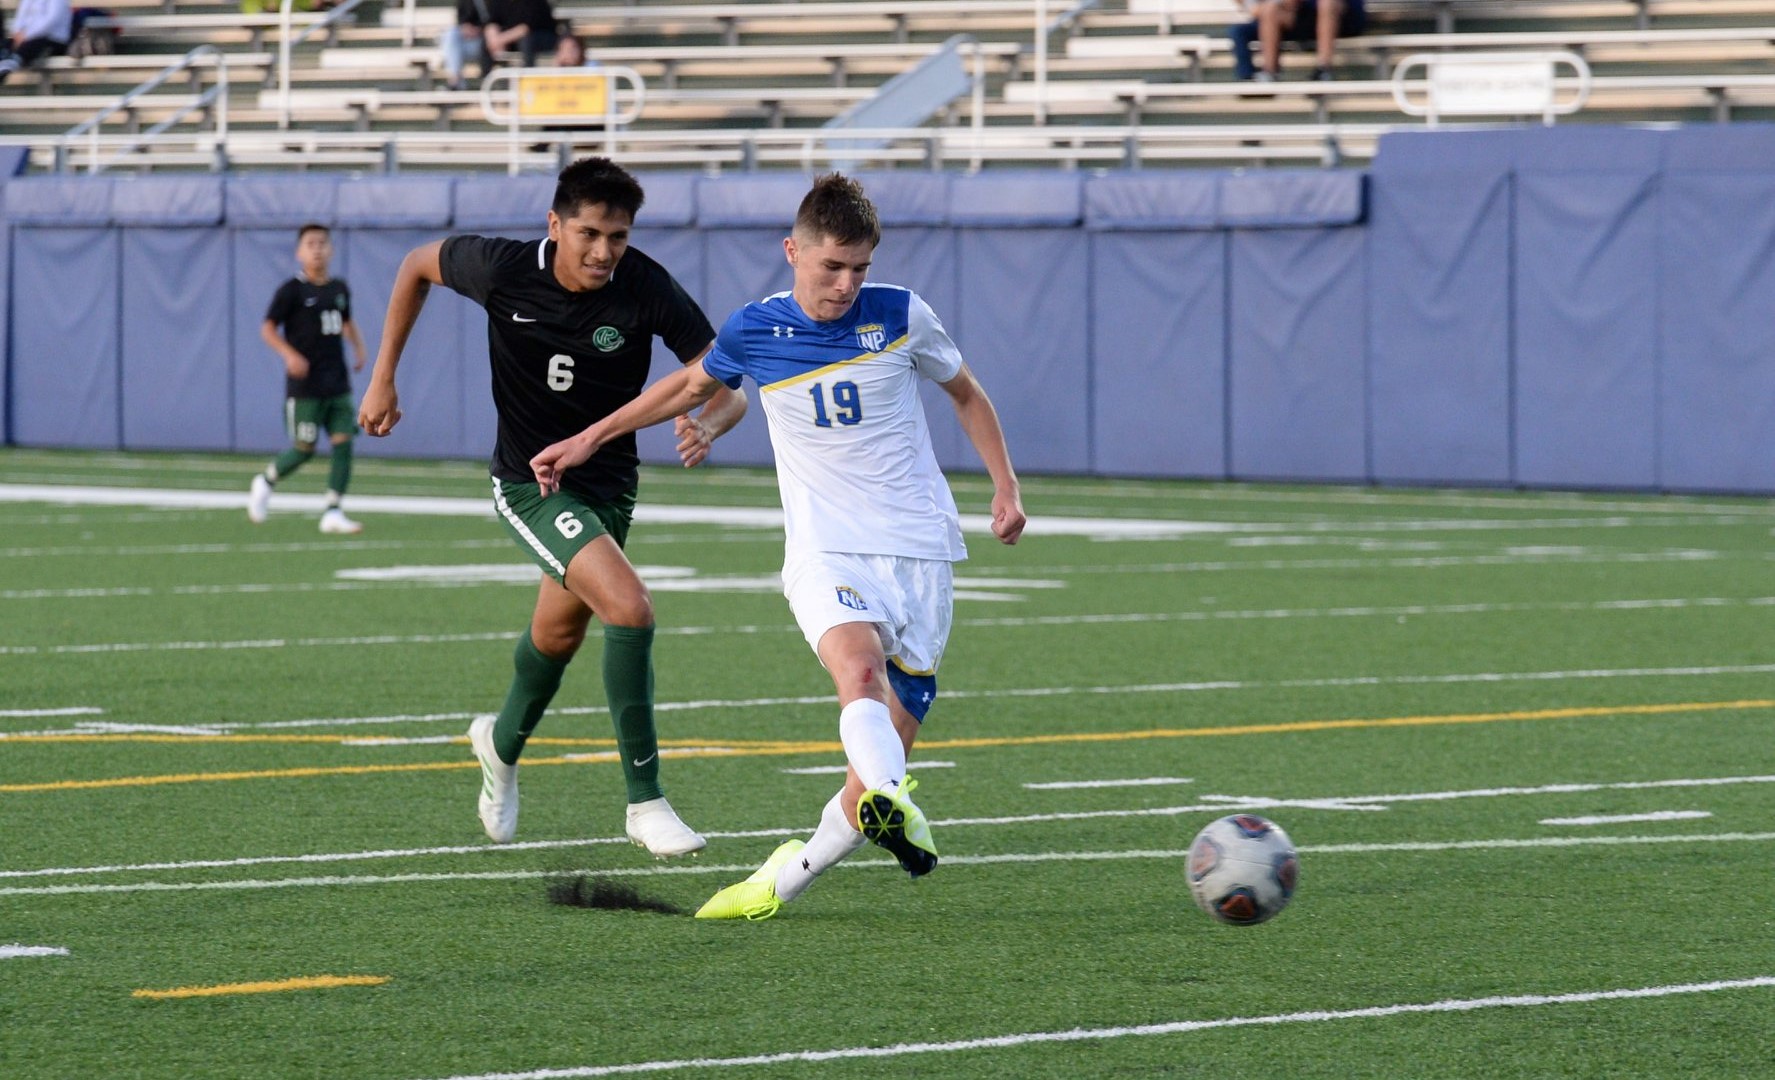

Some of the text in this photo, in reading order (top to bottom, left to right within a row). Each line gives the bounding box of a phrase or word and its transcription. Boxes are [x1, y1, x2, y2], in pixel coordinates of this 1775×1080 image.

[859, 330, 886, 351] NP
[547, 353, 575, 391] 6
[808, 380, 863, 428] 19
[554, 511, 584, 539] 6
